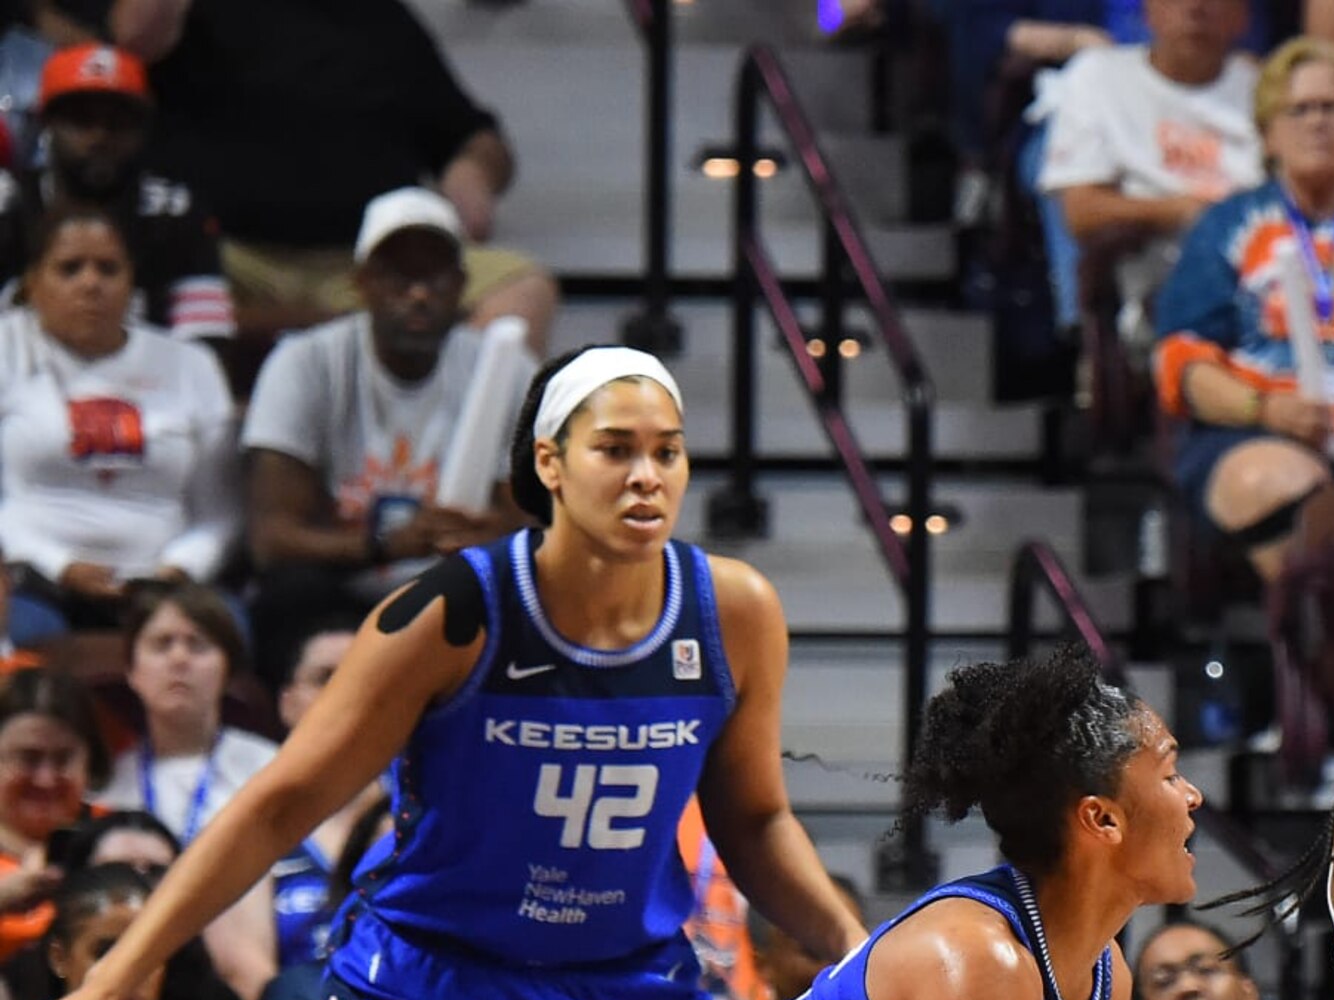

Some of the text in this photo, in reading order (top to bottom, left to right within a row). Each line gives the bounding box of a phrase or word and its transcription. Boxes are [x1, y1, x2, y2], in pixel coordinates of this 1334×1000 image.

[485, 717, 702, 751] KEESUSK
[533, 763, 660, 850] 42
[527, 862, 569, 883] Yale
[524, 881, 626, 906] NewHaven
[518, 897, 588, 924] Health
